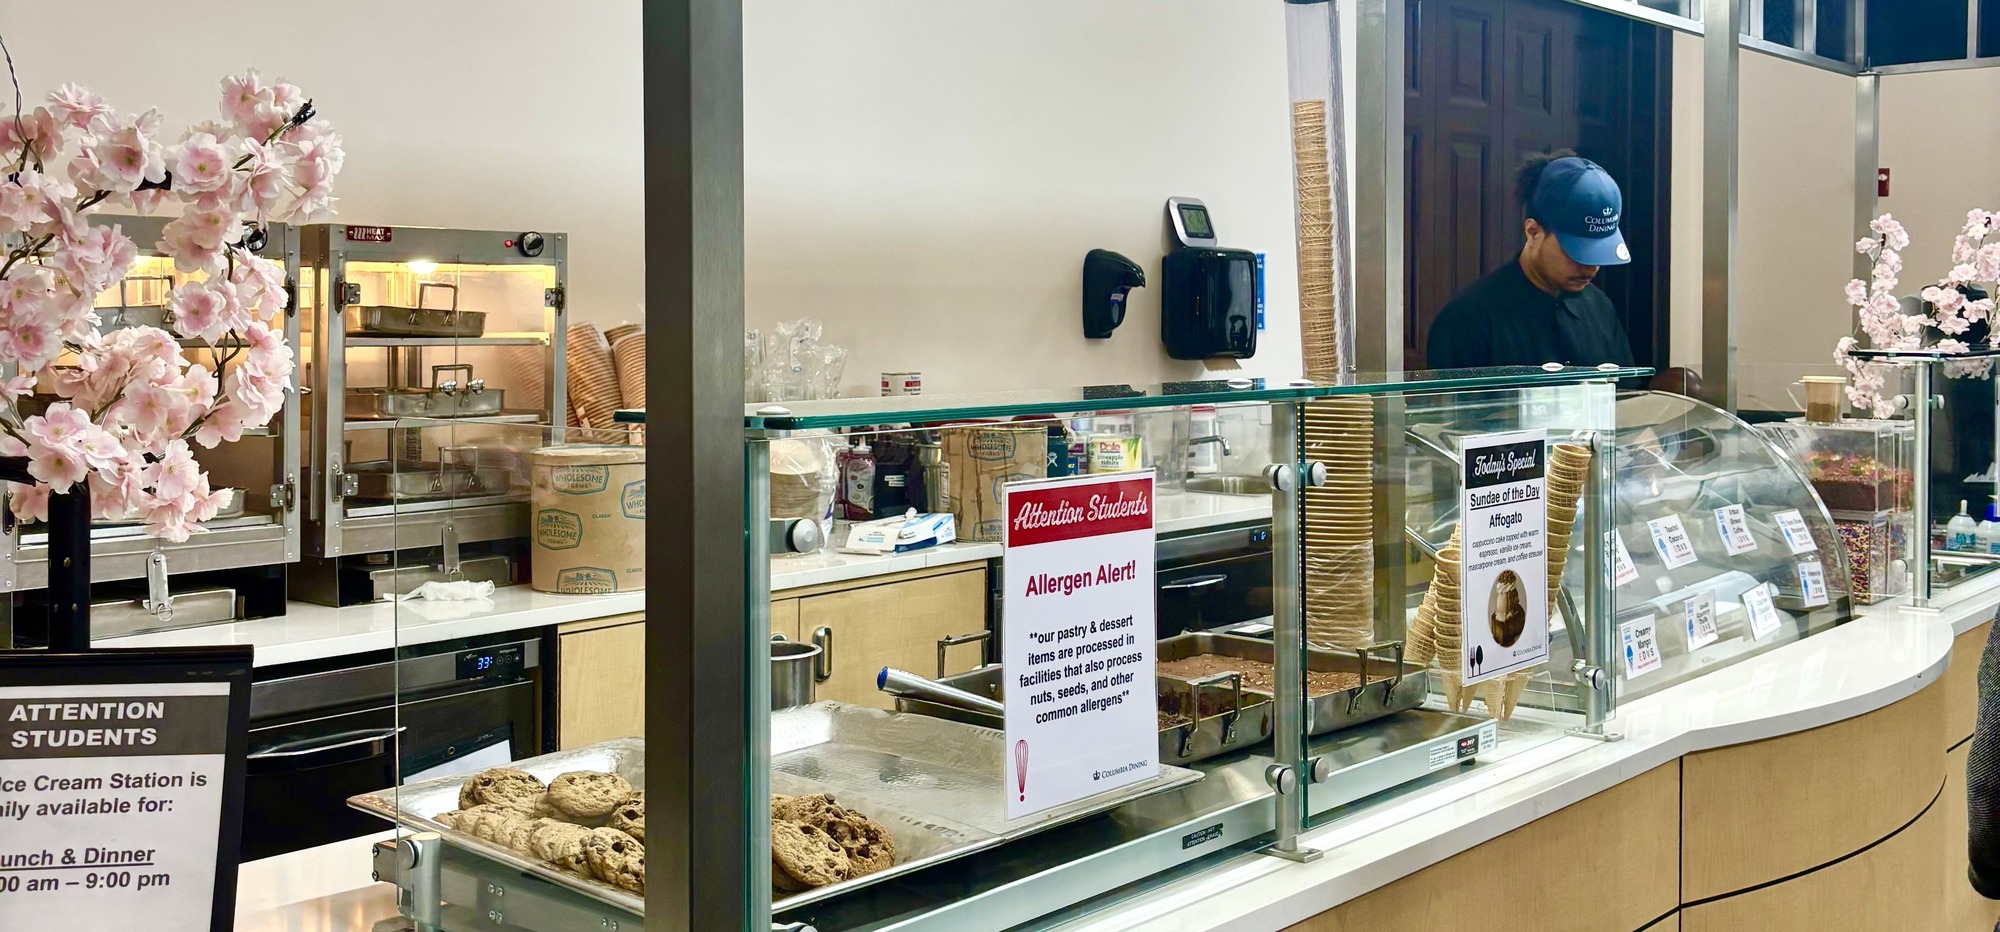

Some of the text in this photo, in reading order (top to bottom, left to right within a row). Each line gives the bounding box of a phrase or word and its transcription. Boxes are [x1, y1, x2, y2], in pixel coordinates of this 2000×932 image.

[366, 227, 385, 235] HEAT
[1588, 222, 1616, 232] DINING
[1099, 442, 1121, 452] Dole
[1097, 455, 1123, 463] pineapple
[1474, 448, 1537, 480] Today's Special
[554, 474, 604, 485] WHOLESOME
[625, 500, 646, 510] WHO
[1470, 484, 1540, 508] Sundae of the Day
[1013, 491, 1149, 531] Attention Students
[1489, 512, 1523, 529] Affogato
[540, 529, 578, 541] WHOLESOME
[1495, 535, 1506, 545] cake
[1505, 532, 1520, 542] topped
[1520, 531, 1529, 539] with
[1468, 560, 1494, 571] mascarpone
[1507, 555, 1516, 563] and
[1515, 552, 1529, 561] coffee
[1025, 559, 1136, 597] Allergen Alert!
[1057, 624, 1088, 643] pastry
[1089, 620, 1097, 634] &
[1099, 614, 1134, 632] dessert
[1635, 626, 1652, 638] Creamy
[1028, 633, 1135, 666] items are processed in
[1637, 638, 1652, 649] Mango
[1019, 651, 1143, 688] facilities that also process
[1030, 672, 1135, 706] nuts, seeds, and other
[8, 701, 165, 722] ATTENTION
[1035, 704, 1078, 725] common
[11, 727, 157, 748] STUDENTS
[1101, 759, 1148, 779] COLUMBIA DINING
[33, 774, 103, 792] Cream
[109, 772, 184, 790] Station
[190, 771, 208, 788] is
[36, 798, 131, 817] available
[137, 796, 173, 813] for:
[61, 848, 77, 865] &
[84, 847, 156, 864] Dinner
[26, 877, 59, 891] am
[85, 871, 131, 889] 9:00
[137, 872, 171, 891] pm
